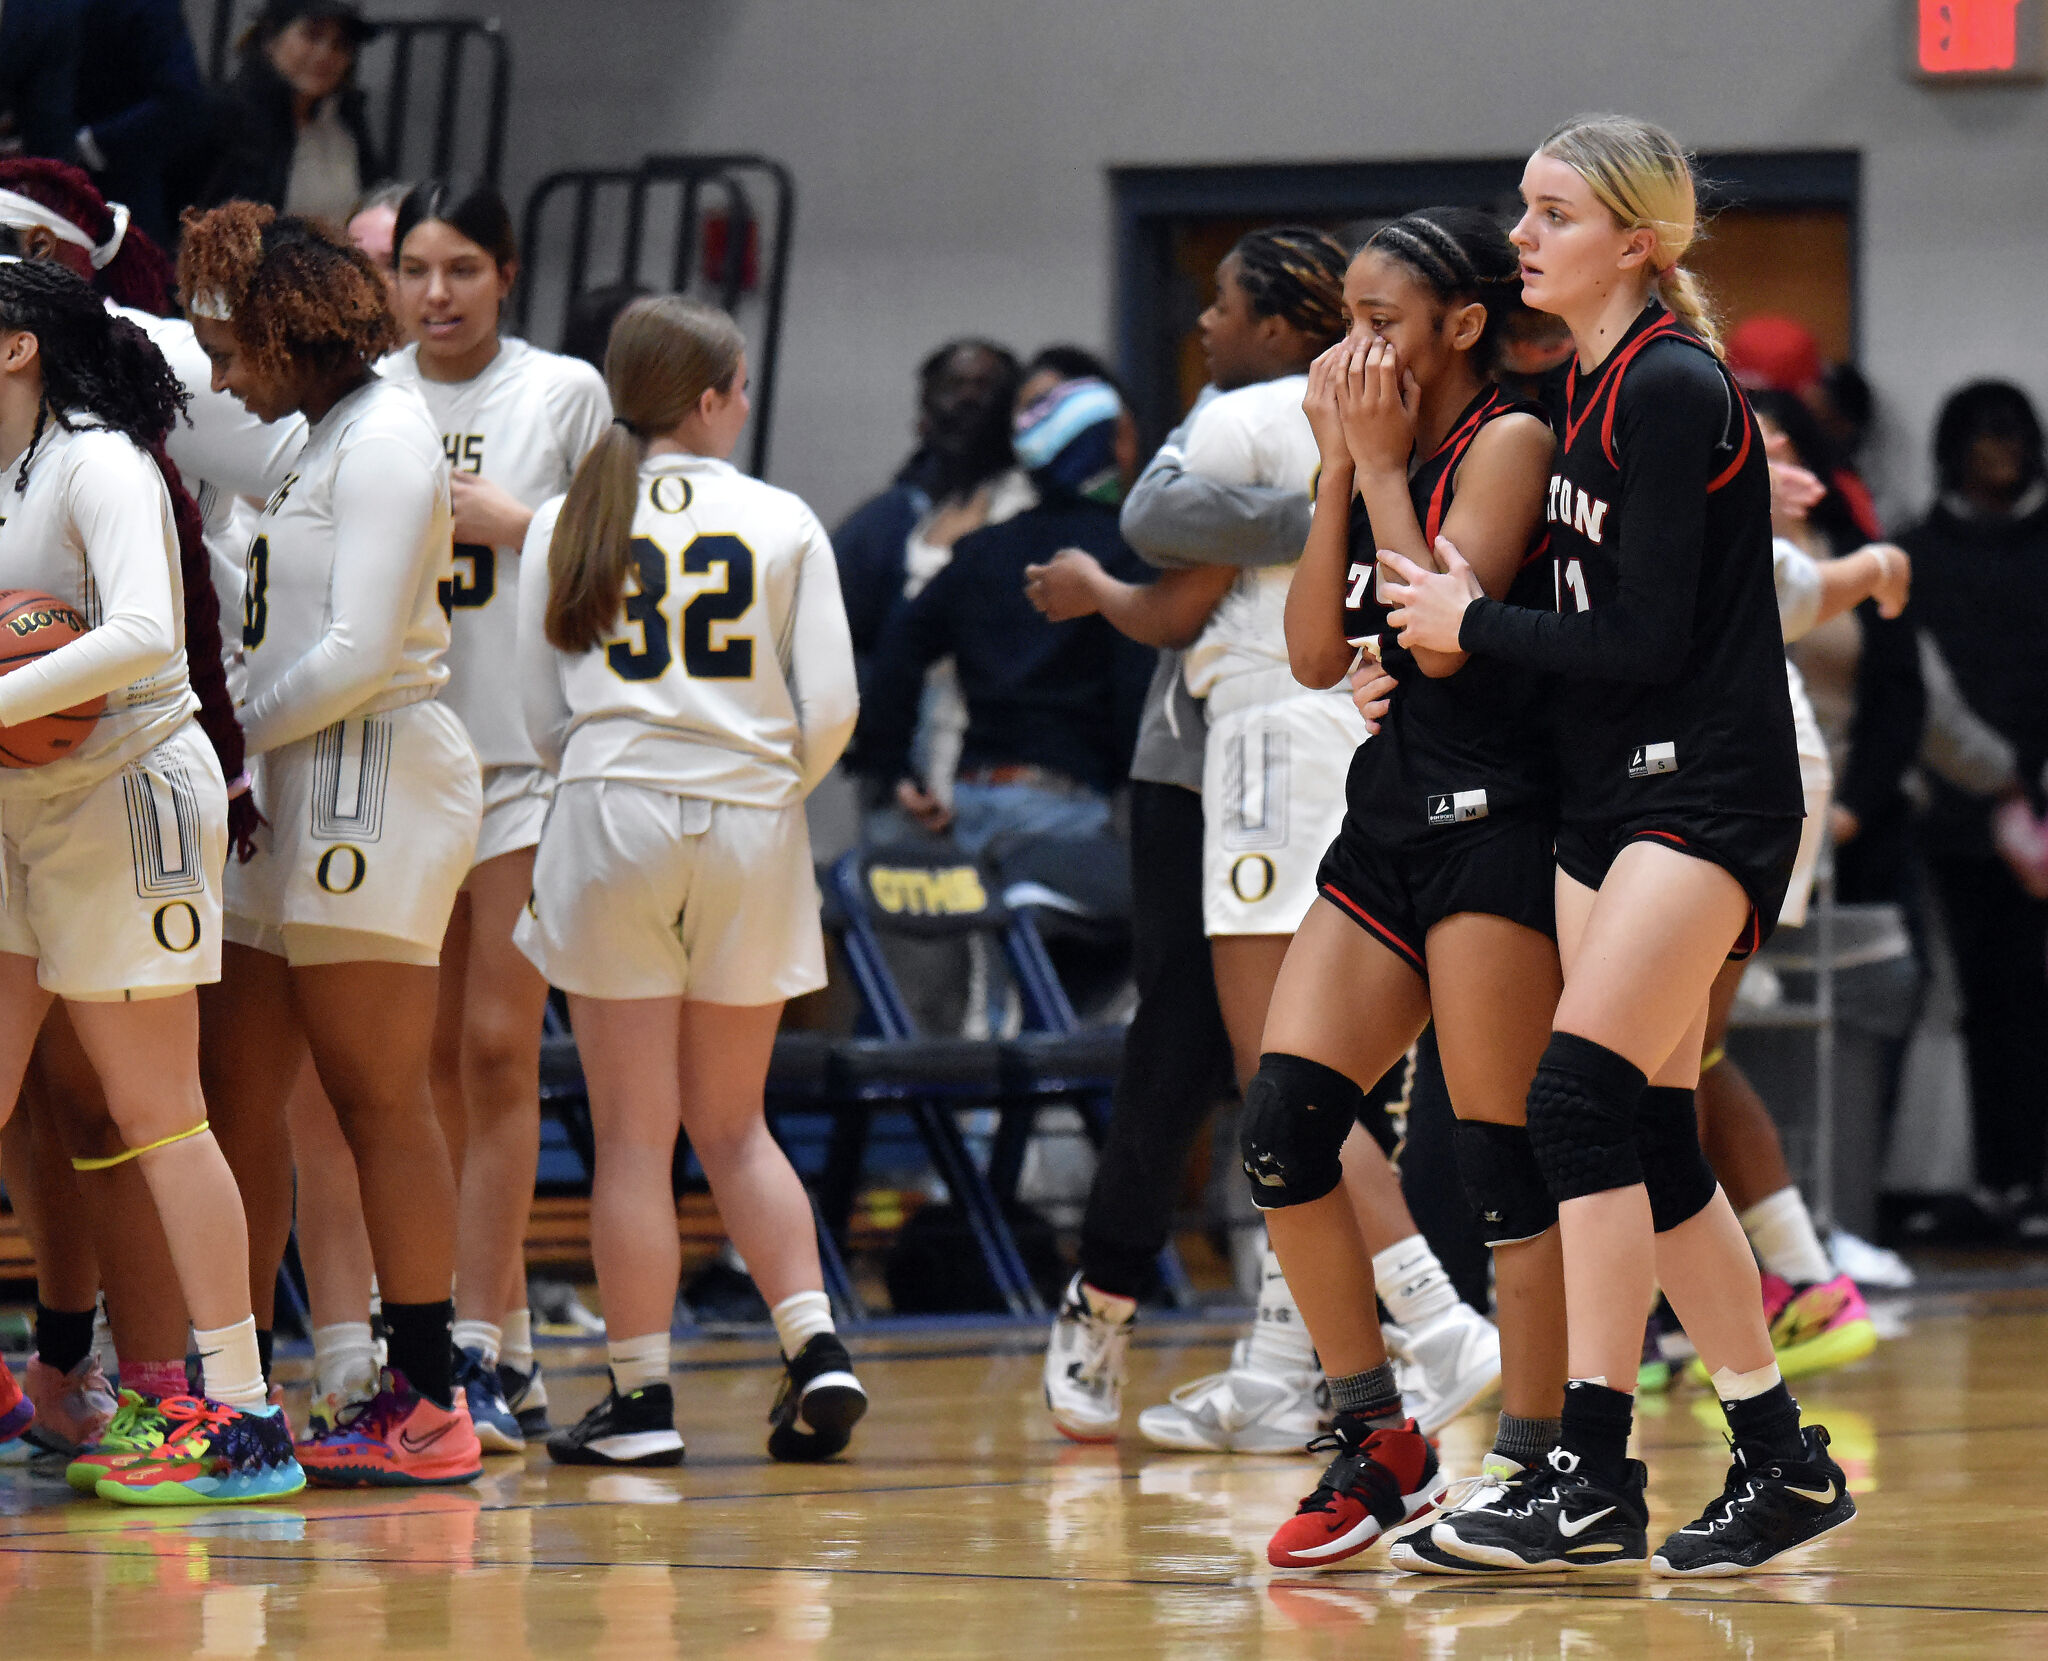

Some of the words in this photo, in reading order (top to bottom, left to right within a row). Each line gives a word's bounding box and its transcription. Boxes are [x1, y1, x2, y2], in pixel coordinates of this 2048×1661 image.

[649, 476, 694, 514] O
[1546, 473, 1610, 545] TON
[605, 531, 757, 684] 32
[1345, 560, 1394, 611] 7
[1553, 557, 1592, 613] 1
[1464, 807, 1477, 817] M
[316, 843, 367, 895] O
[1229, 853, 1277, 904] O
[152, 900, 201, 952] O
